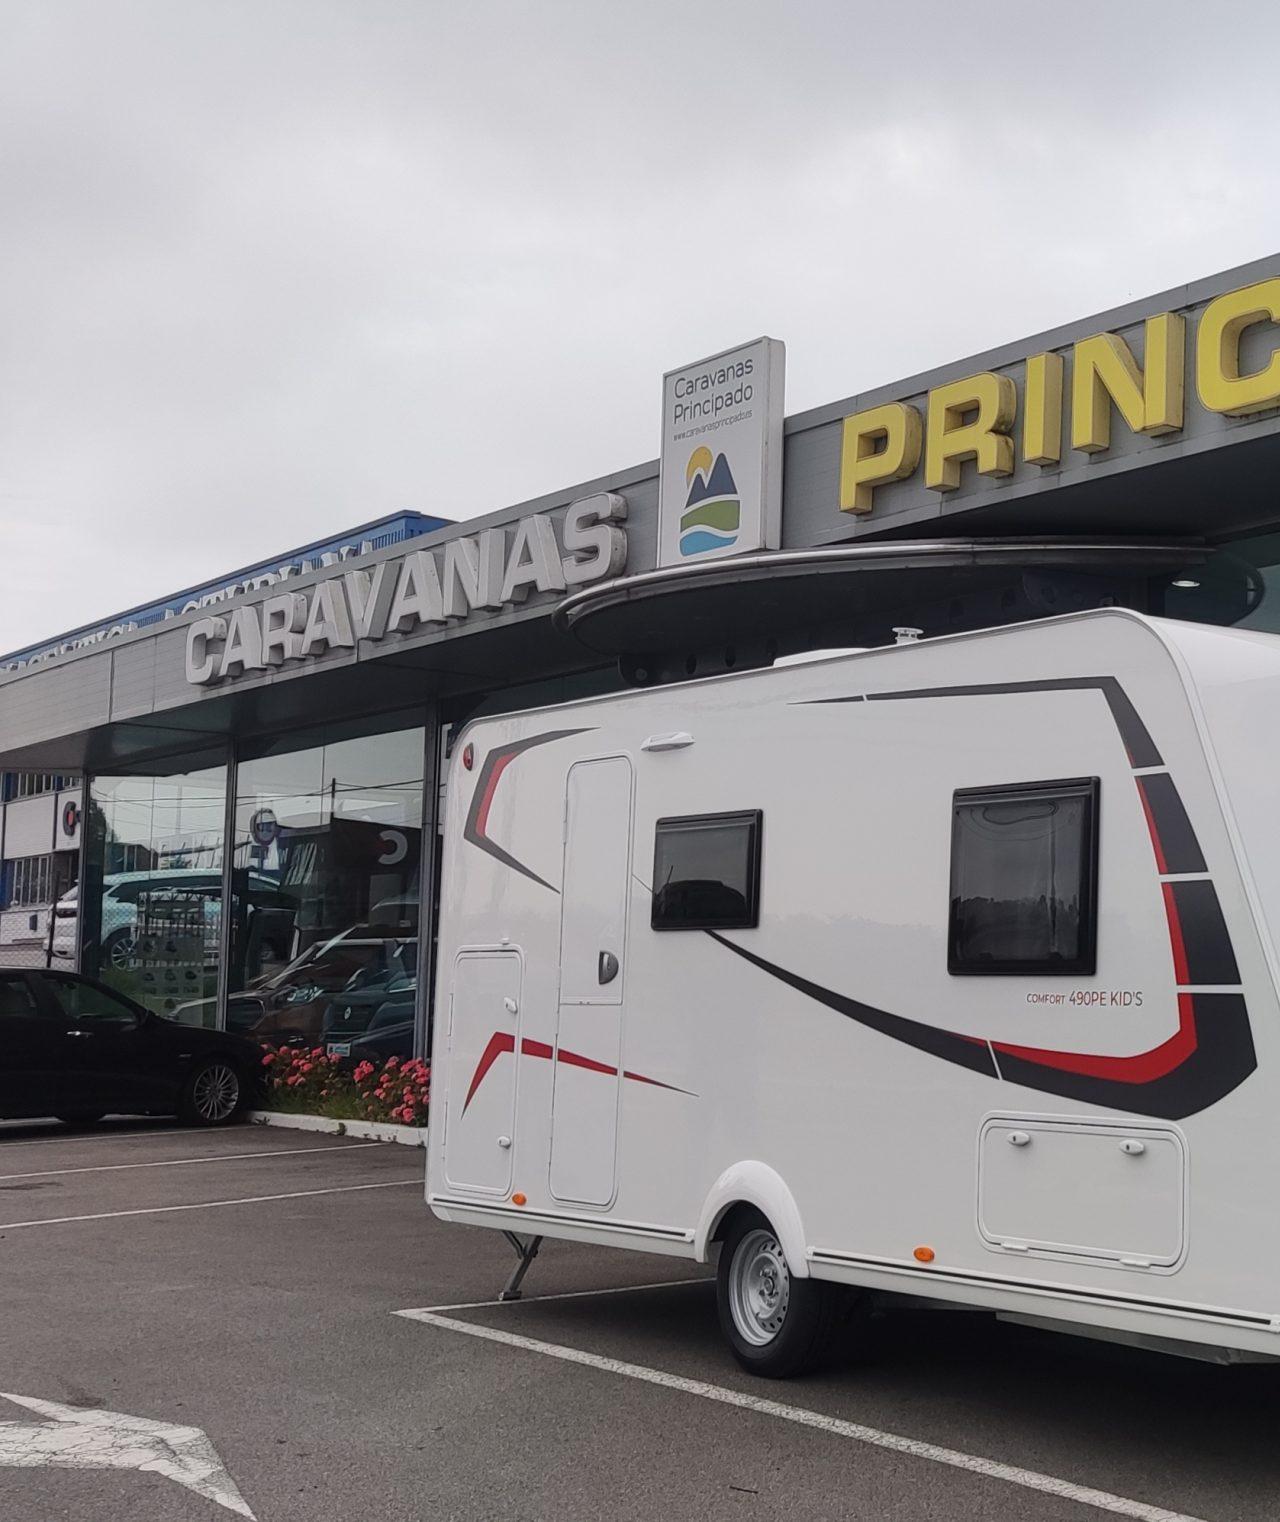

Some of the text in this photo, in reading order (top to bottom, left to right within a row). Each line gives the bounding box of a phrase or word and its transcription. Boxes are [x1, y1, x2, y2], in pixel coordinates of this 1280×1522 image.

[674, 359, 754, 398] Caravanas
[674, 382, 753, 424] Principado
[185, 492, 628, 685] CARAVANAS
[1026, 990, 1143, 1007] COMFORT 490PE KID'S
